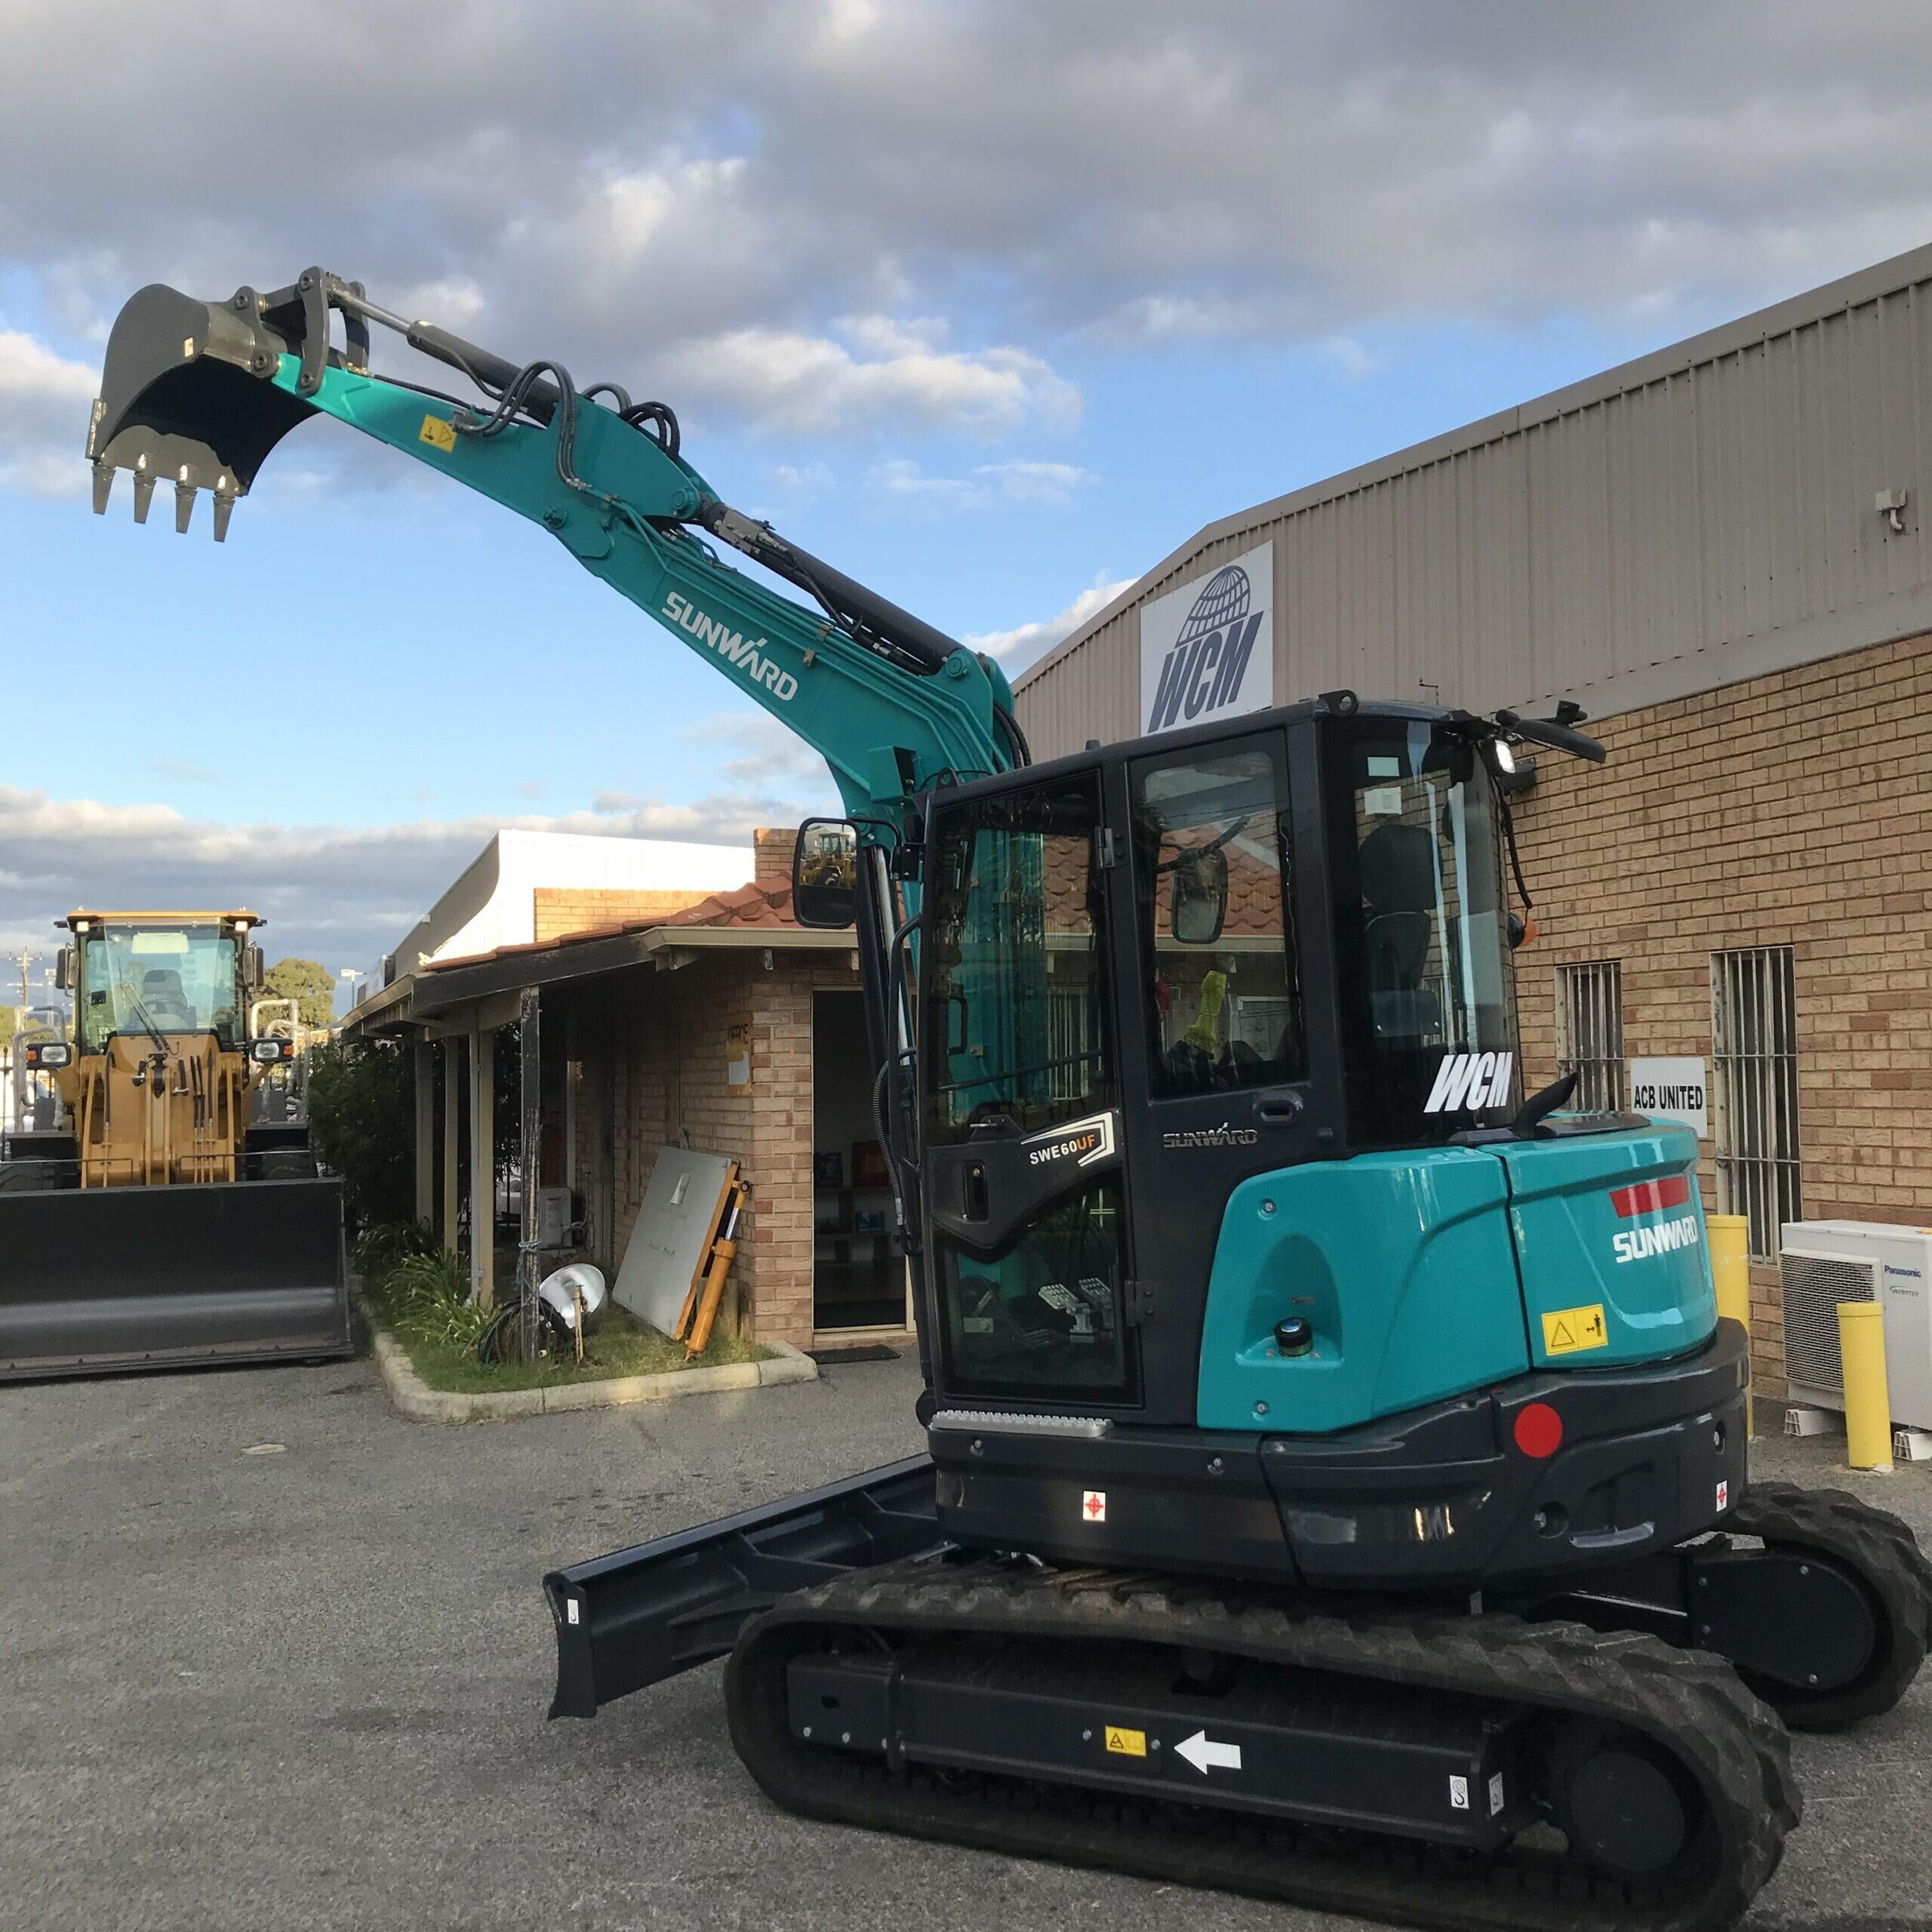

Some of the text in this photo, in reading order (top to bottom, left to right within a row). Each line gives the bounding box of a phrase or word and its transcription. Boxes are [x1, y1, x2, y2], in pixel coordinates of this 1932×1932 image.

[662, 592, 798, 700] SUNWARD
[1148, 611, 1264, 734] WCM
[1423, 1051, 1512, 1112] WCM
[1634, 1084, 1703, 1109] ACB UNITED
[1029, 1134, 1094, 1164] SWE60UF
[1163, 1122, 1257, 1148] SUNWARD
[1613, 1215, 1697, 1263] SUNWARD
[1884, 1265, 1921, 1278] Panasonic
